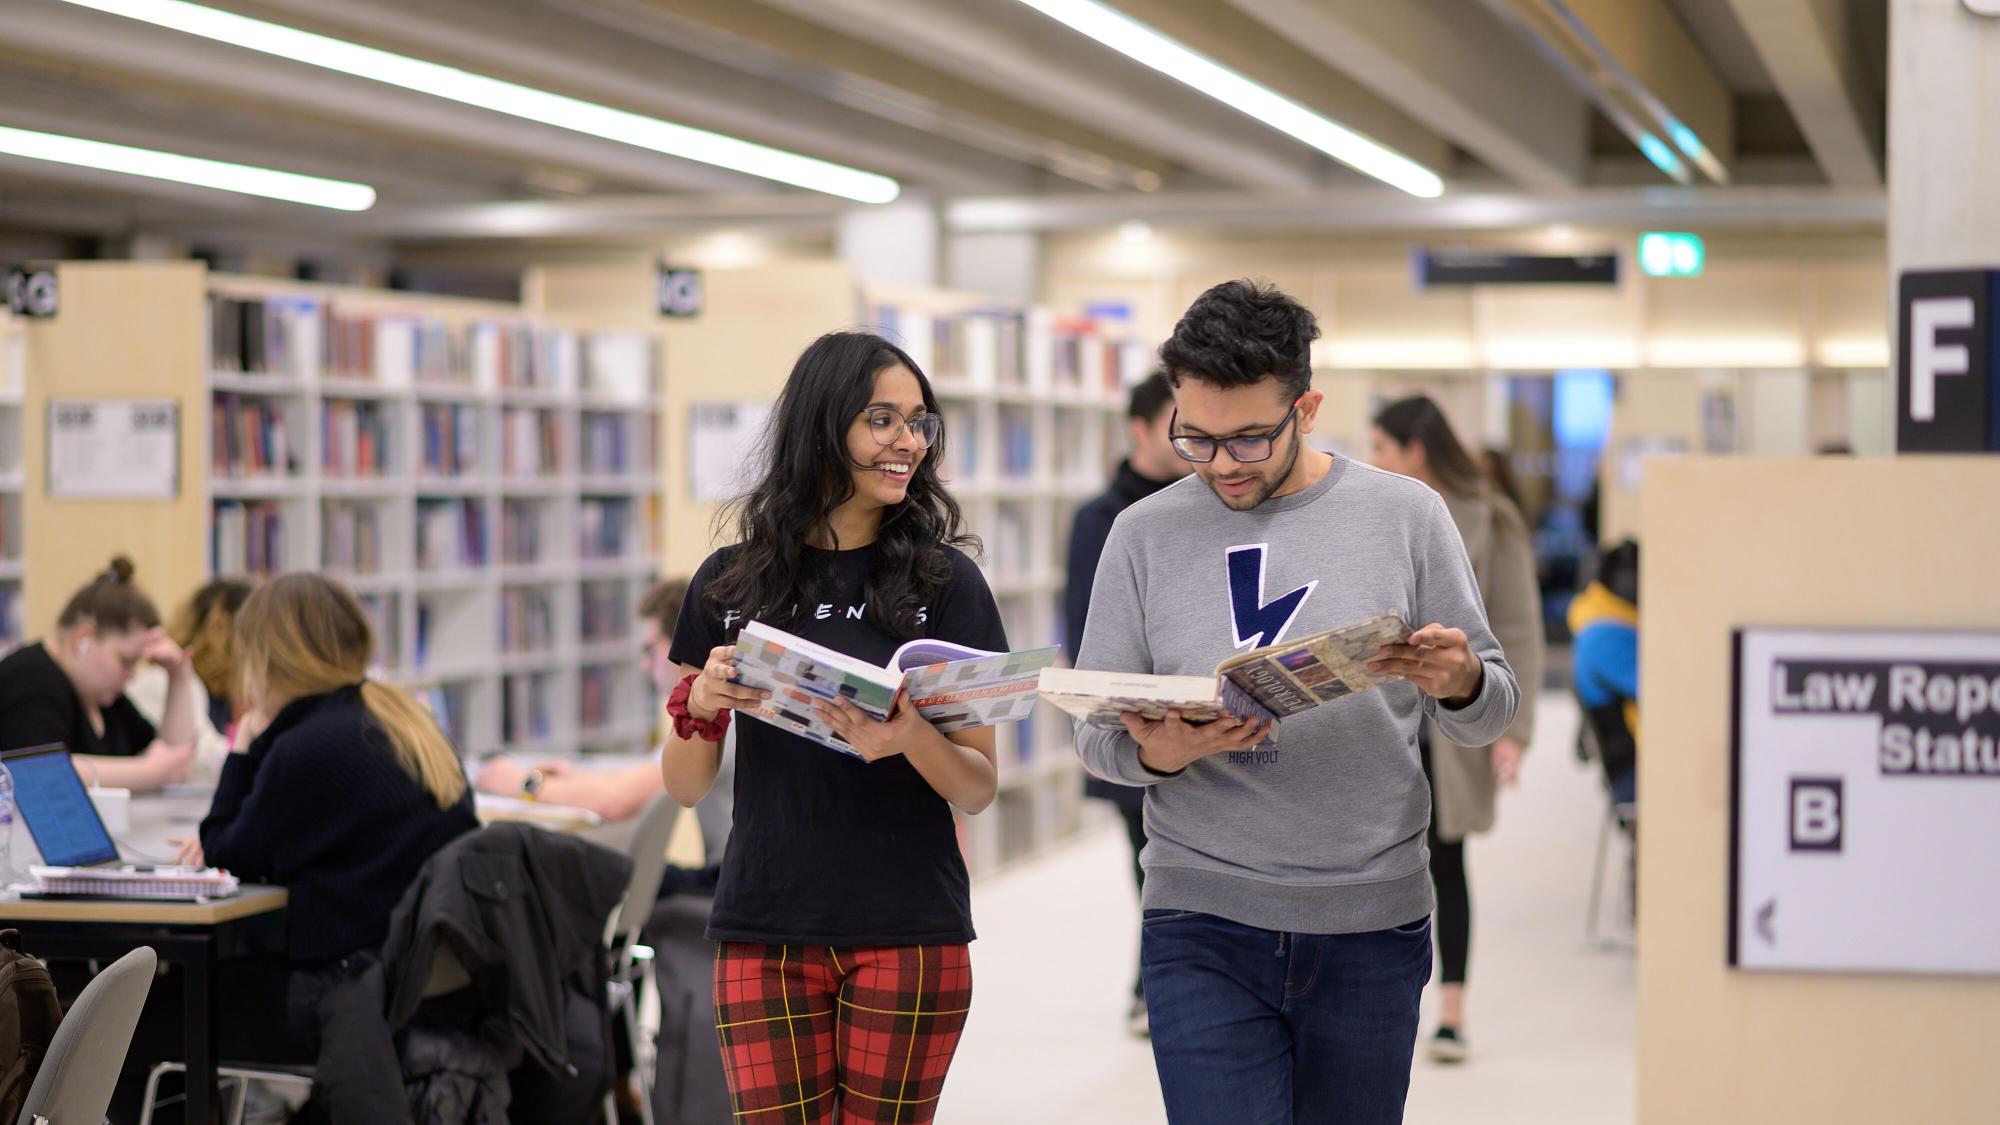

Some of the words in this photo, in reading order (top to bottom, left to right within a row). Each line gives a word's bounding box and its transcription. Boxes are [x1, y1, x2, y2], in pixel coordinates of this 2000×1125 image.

[1910, 297, 1974, 421] F
[913, 682, 1034, 706] ACROECONOMICS
[1246, 665, 1307, 712] PETROLOGY
[1774, 664, 1877, 709] Law
[1228, 751, 1253, 764] HIGH
[1255, 750, 1280, 763] VOLT
[1792, 785, 1840, 844] B
